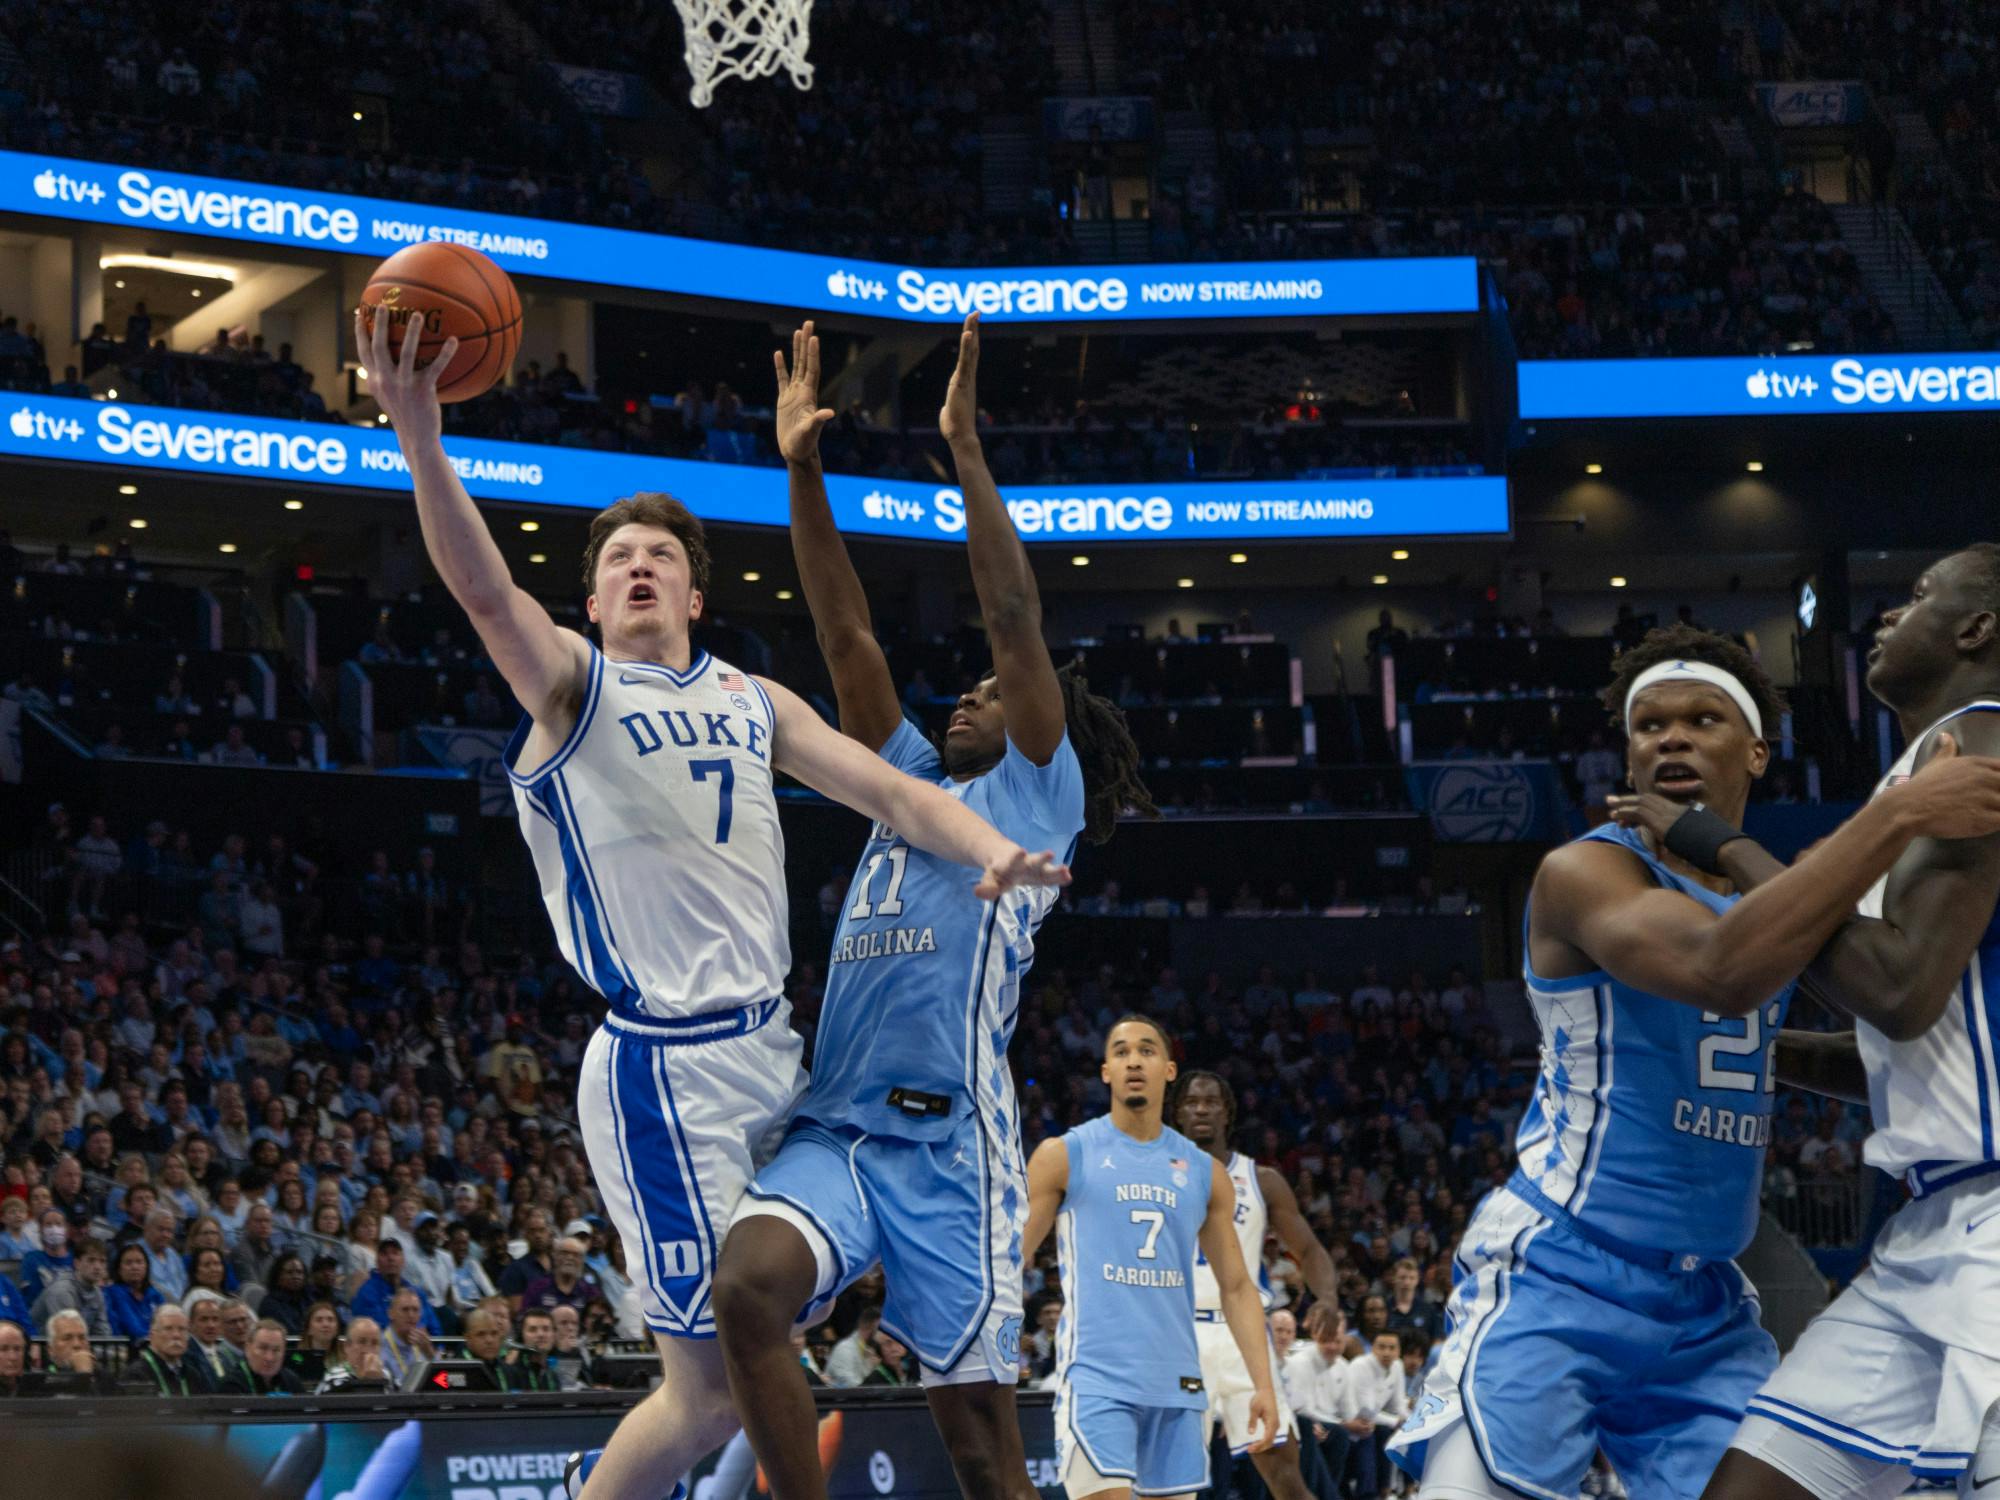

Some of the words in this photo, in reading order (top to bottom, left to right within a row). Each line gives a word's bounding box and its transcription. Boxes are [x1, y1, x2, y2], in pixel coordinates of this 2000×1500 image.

[117, 171, 359, 243] Severance
[372, 219, 424, 242] NOW
[427, 226, 548, 260] STREAMING
[897, 270, 1128, 320] Severance
[1141, 283, 1195, 302] NOW
[1198, 279, 1323, 301] STREAMING
[1831, 359, 2000, 404] Severa
[97, 406, 347, 475] Severance
[361, 449, 411, 473] NOW
[934, 489, 1173, 533] Serance
[1186, 501, 1242, 522] NOW
[1245, 499, 1374, 521] STREAMING
[618, 711, 767, 761] DUKE
[688, 758, 735, 844] 7
[1444, 785, 1523, 812] ACC
[850, 846, 910, 922] 11
[1115, 1183, 1177, 1208] NORTH
[1130, 1209, 1165, 1260] 7
